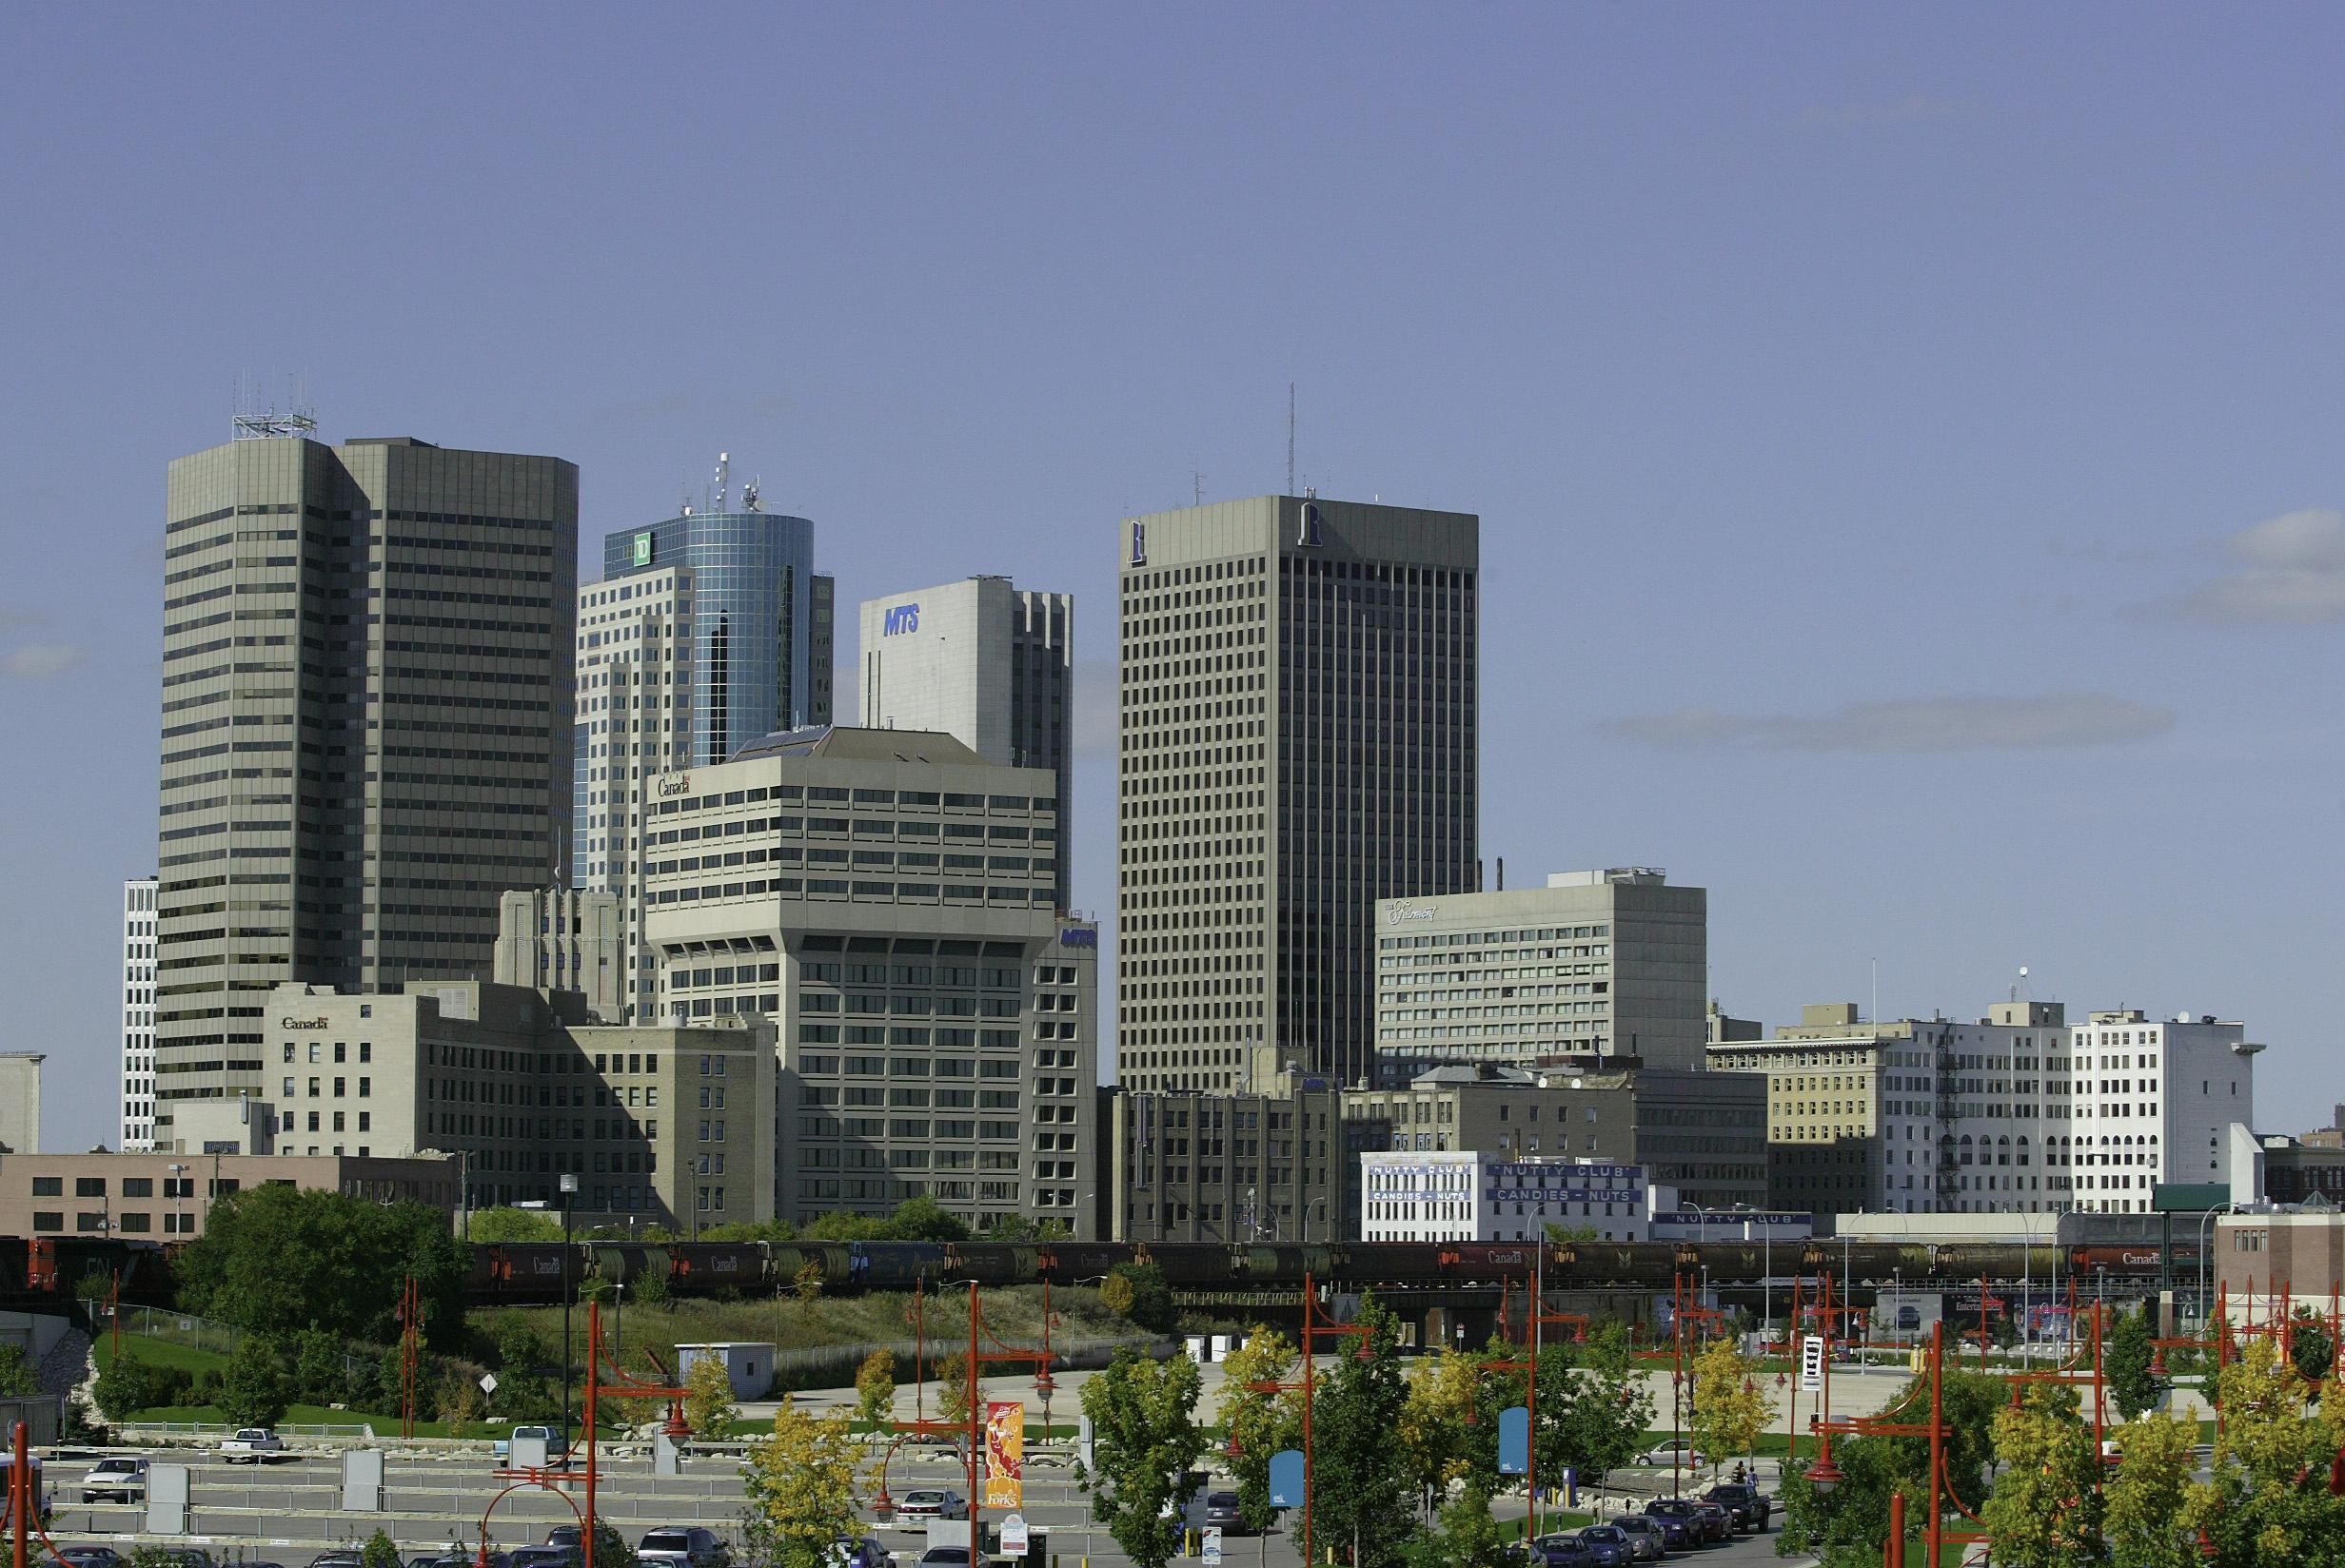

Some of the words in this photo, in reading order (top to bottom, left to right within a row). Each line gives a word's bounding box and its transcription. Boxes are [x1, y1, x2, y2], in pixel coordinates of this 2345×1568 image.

[883, 603, 919, 637] MTS
[658, 774, 691, 797] Canada
[282, 1016, 328, 1029] Canada
[1497, 1189, 1569, 1201] CANDIES
[1588, 1191, 1630, 1202] NUTS
[711, 1255, 738, 1272] Canada
[1488, 1250, 1523, 1264] Canada
[533, 1256, 561, 1274] Canada
[988, 1493, 1017, 1507] Forks
